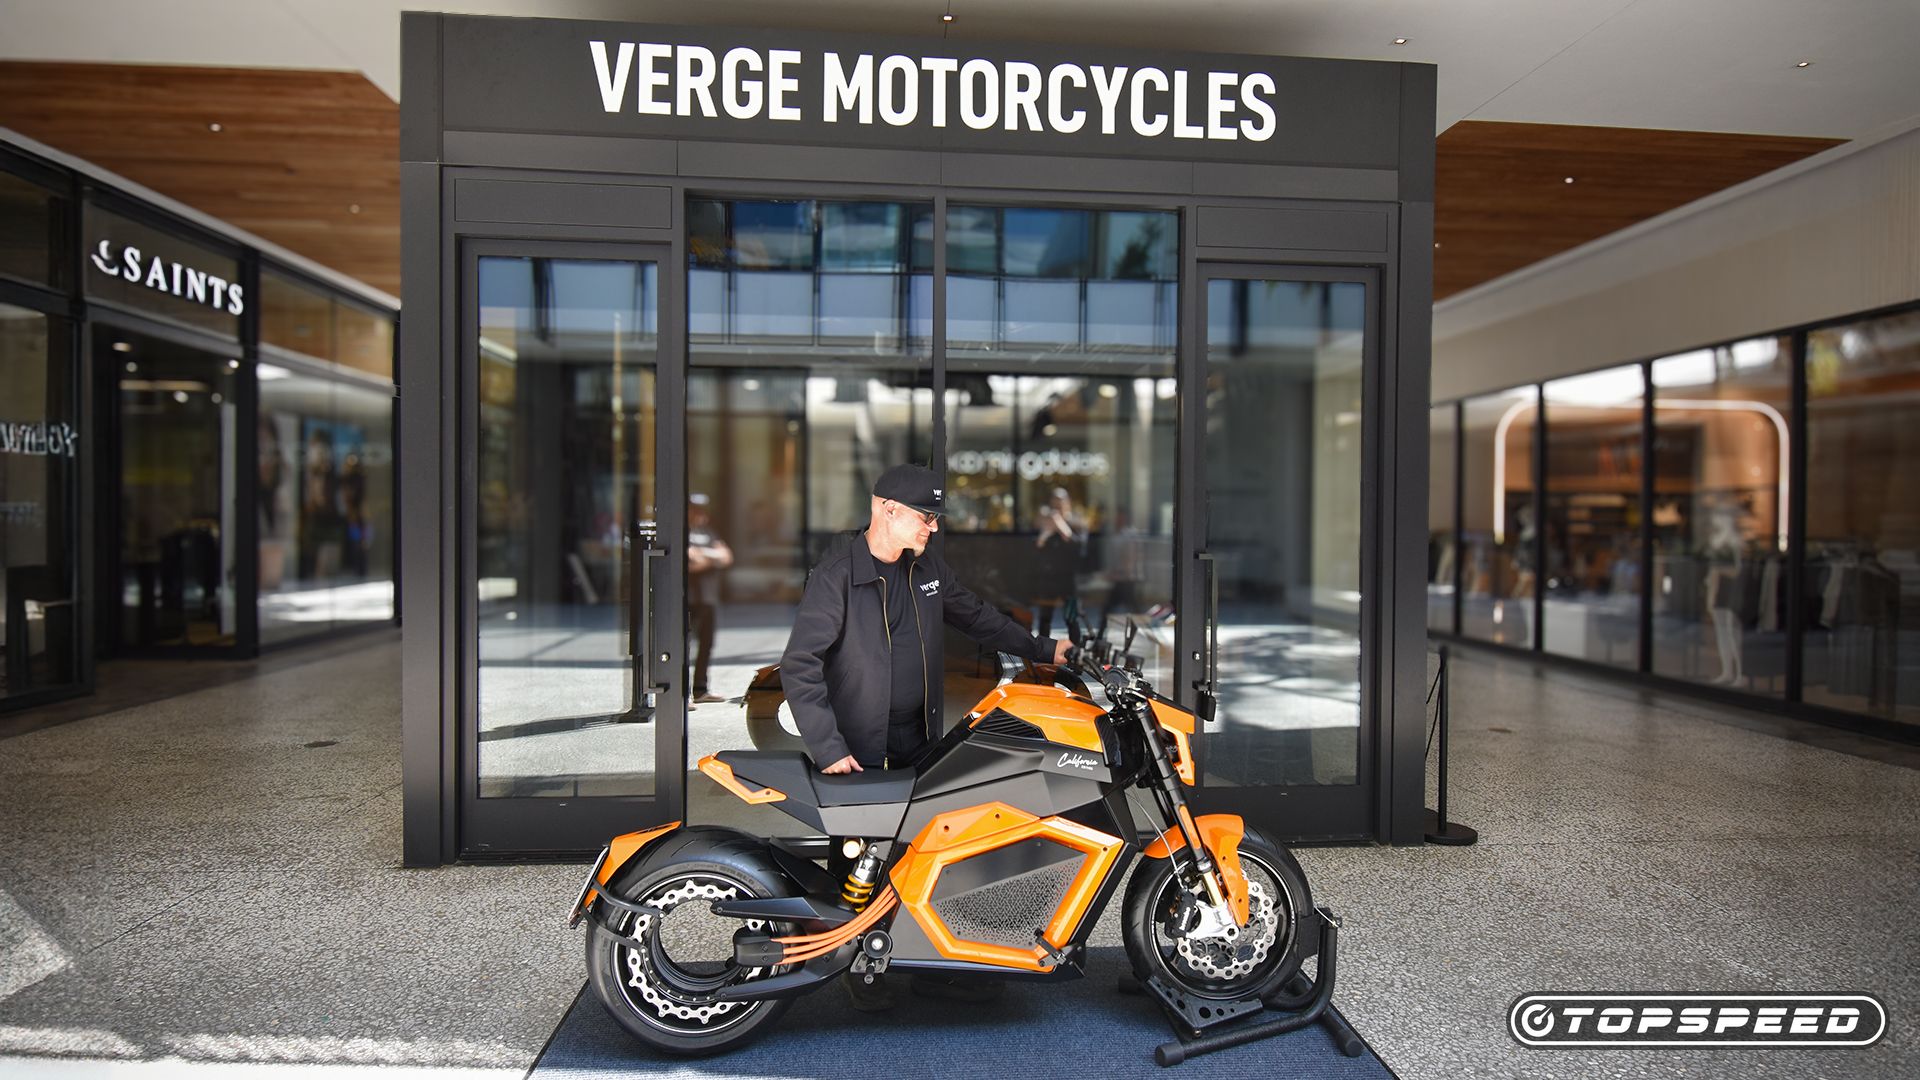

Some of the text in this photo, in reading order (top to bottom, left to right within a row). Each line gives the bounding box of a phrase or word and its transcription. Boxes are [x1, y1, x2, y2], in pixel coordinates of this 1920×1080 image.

[589, 41, 1276, 141] VERGE MOTORCYCLES
[123, 246, 244, 316] SAINTS
[1057, 752, 1099, 768] California
